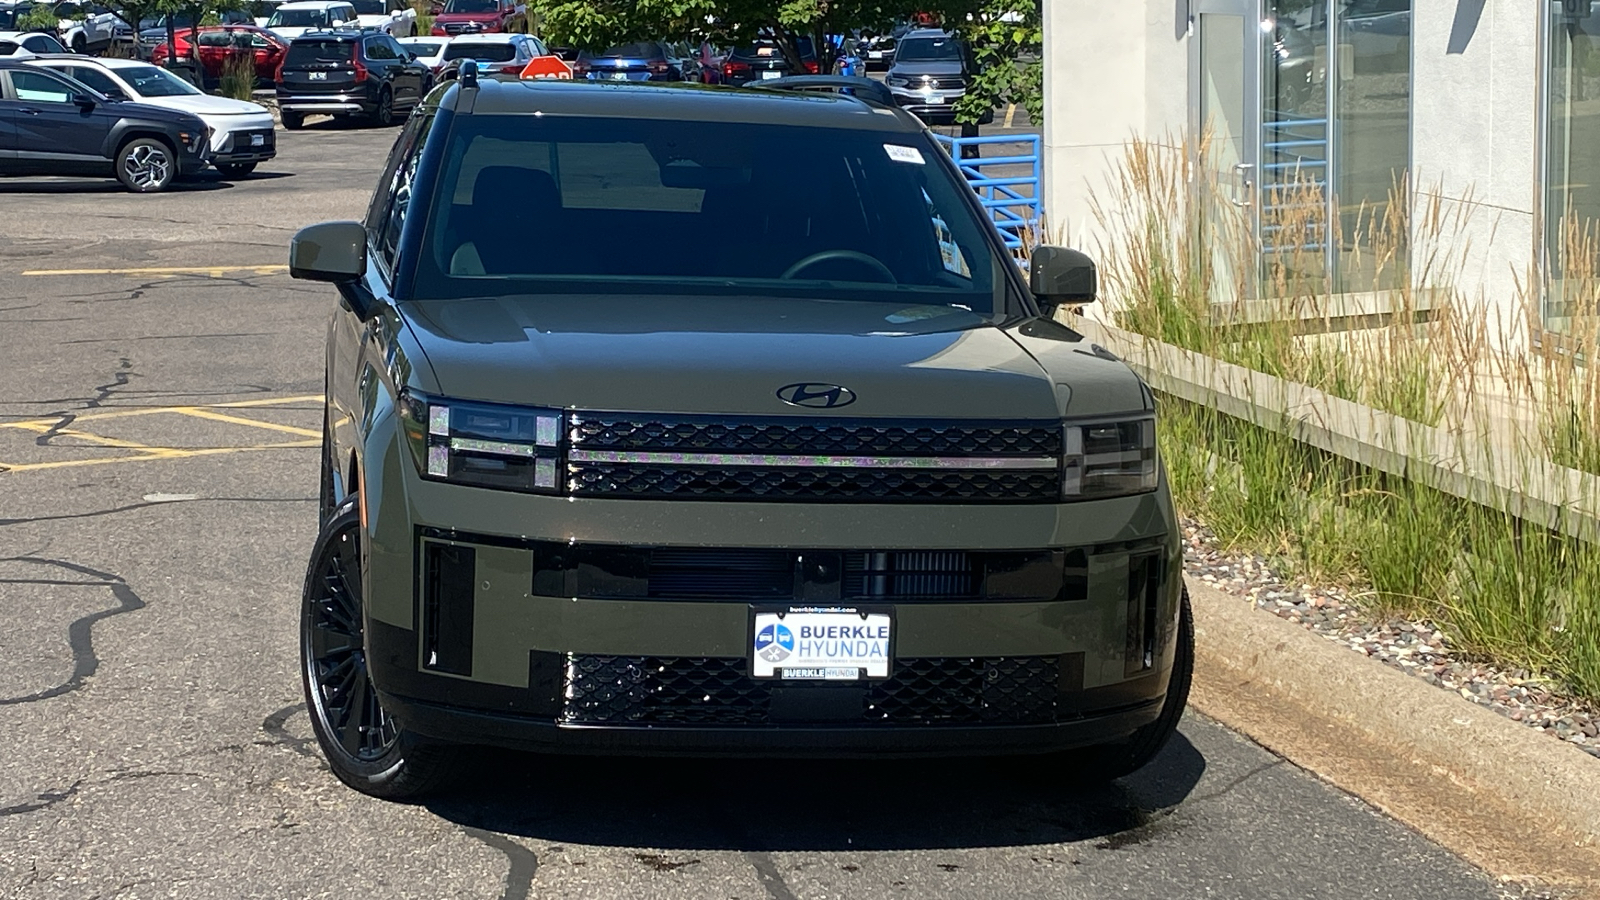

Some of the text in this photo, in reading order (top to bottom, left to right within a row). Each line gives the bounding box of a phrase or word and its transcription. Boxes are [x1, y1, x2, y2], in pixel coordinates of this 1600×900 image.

[800, 626, 888, 639] BUERKLE
[799, 640, 889, 657] HYUNDAI
[783, 668, 857, 678] BUERKLE HYUNDAI
